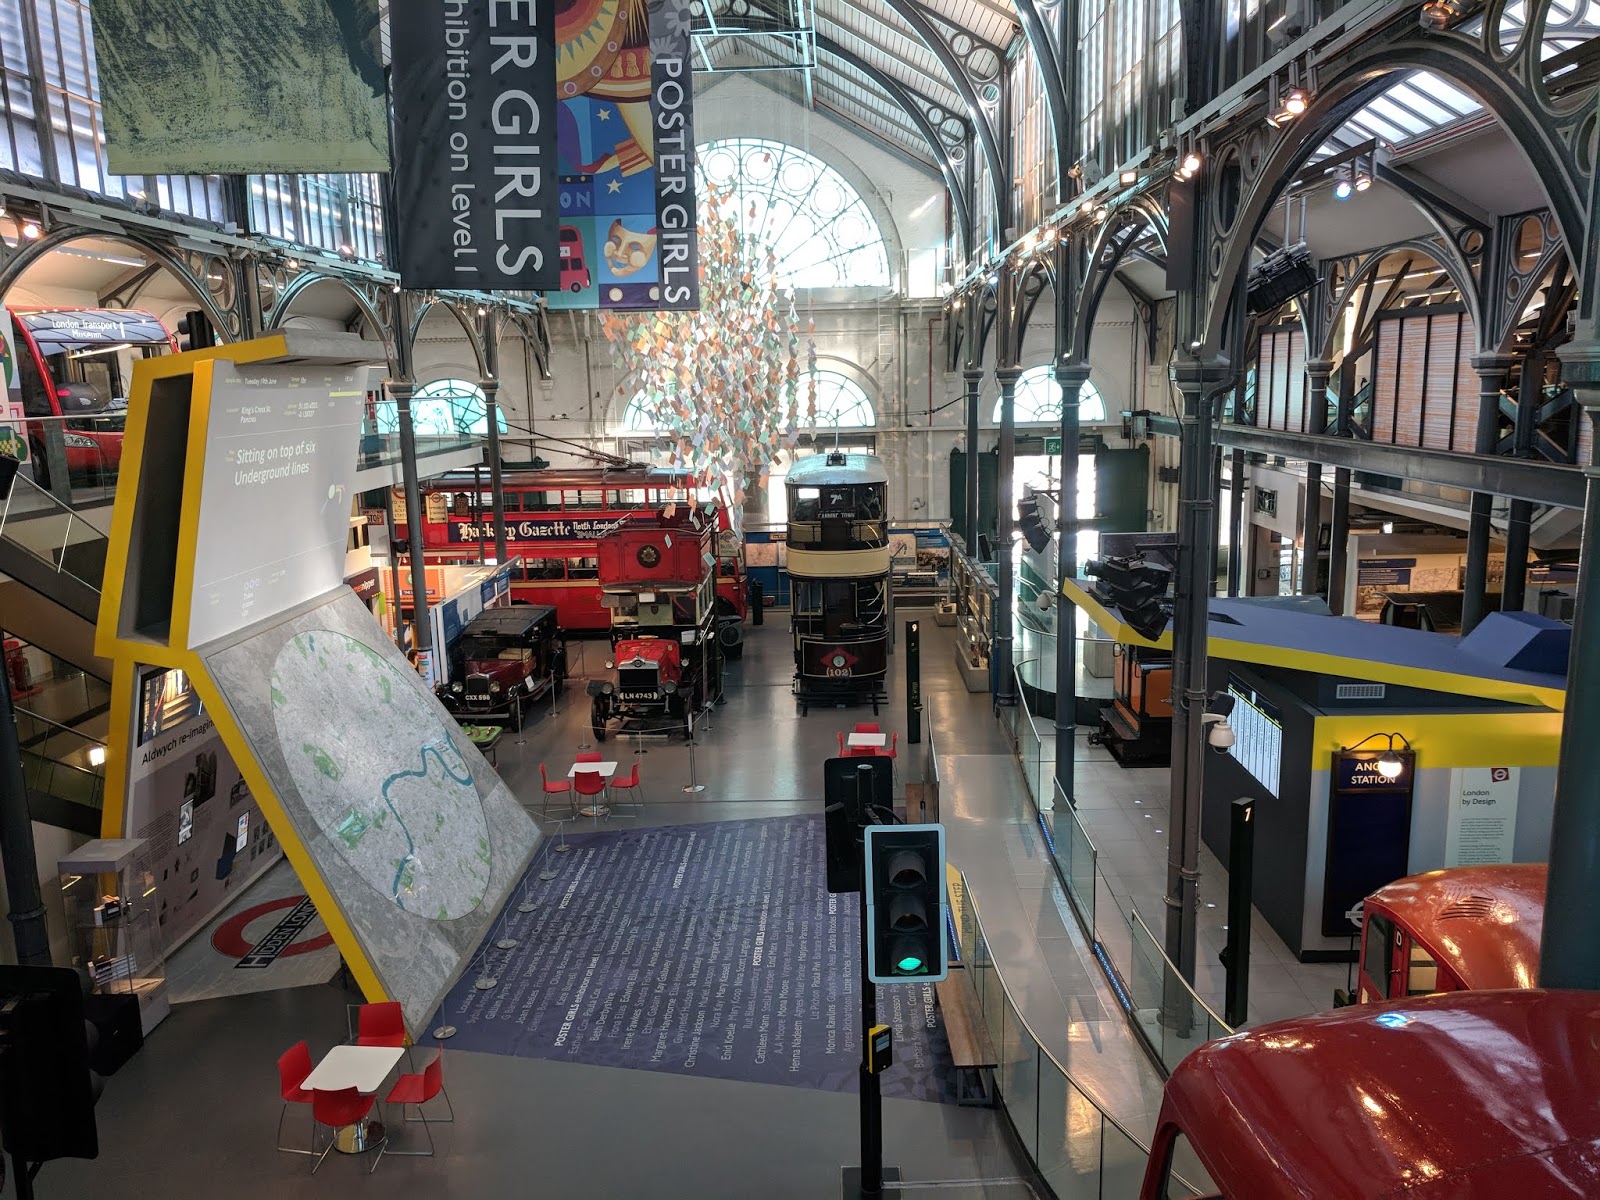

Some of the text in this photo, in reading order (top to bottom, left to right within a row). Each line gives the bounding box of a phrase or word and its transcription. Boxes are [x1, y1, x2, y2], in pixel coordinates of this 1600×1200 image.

[450, 132, 468, 172] on
[491, 90, 544, 276] GIRLS
[656, 58, 690, 304] POSTER GIRLS
[451, 184, 478, 258] level
[52, 319, 118, 331] London Transport
[237, 448, 266, 466] Sitting
[268, 446, 278, 459] on
[280, 445, 294, 460] top
[296, 442, 306, 454] of
[306, 440, 316, 454] six
[234, 460, 310, 486] Underground lines
[458, 522, 516, 542] Haky
[518, 520, 571, 537] Gazette
[142, 720, 215, 766] Aldwych re-imagin
[1351, 775, 1396, 784] STATION
[677, 862, 686, 873] GIRLS
[672, 873, 683, 888] POSTER
[558, 892, 572, 908] POSTER
[567, 880, 578, 892] GIRLS
[758, 910, 767, 930] exhibition
[828, 916, 836, 933] Rhodes
[238, 927, 295, 966] HIDDEN
[755, 931, 764, 945] GIRLS
[827, 934, 836, 951] Zandra
[735, 958, 746, 972] Scott
[752, 946, 762, 965] POSTER
[549, 970, 563, 984] Olive
[654, 982, 666, 992] Kay
[556, 992, 568, 1005] Kate
[589, 987, 601, 999] Cox
[715, 982, 728, 997] Mary
[730, 988, 742, 1003] Koop
[778, 980, 789, 998] Moore
[554, 1022, 571, 1045] POSTER
[565, 1004, 579, 1020] GIRLS
[575, 976, 589, 1002] exhibition
[587, 956, 599, 968] level
[582, 1000, 596, 1016] Paula
[607, 969, 638, 1037] Fiona Edwina Ellis
[713, 1000, 725, 1010] Kay
[777, 999, 787, 1016] Mona
[794, 999, 805, 1017] Agnes
[922, 986, 934, 1027] POSTER GIRLS
[515, 1009, 529, 1024] Joan
[589, 992, 615, 1040] Beth Derbyshire
[626, 1008, 641, 1030] Fawkes
[709, 1012, 721, 1027] Nora
[727, 1004, 740, 1020] Mary
[826, 1004, 835, 1028] Rawlins
[843, 996, 852, 1030] Richardson
[892, 995, 904, 1041] Linda Stensson
[576, 1018, 589, 1031] Cox
[650, 1032, 667, 1061] Margaret
[659, 998, 676, 1030] Haythorne
[758, 1014, 769, 1031] Mann
[775, 1019, 785, 1040] Moore
[621, 1032, 634, 1049] Irene
[684, 1036, 699, 1067] Christine
[692, 1010, 704, 1034] Jackson
[724, 1023, 735, 1043] Koelle
[792, 1020, 802, 1047] Nadeem
[825, 1029, 835, 1053] Monica
[843, 1029, 854, 1052] Agnes
[720, 1044, 732, 1060] Enid
[754, 1033, 767, 1063] Cathleen
[910, 1041, 923, 1067] Barbara
[789, 1049, 800, 1071] Henna
